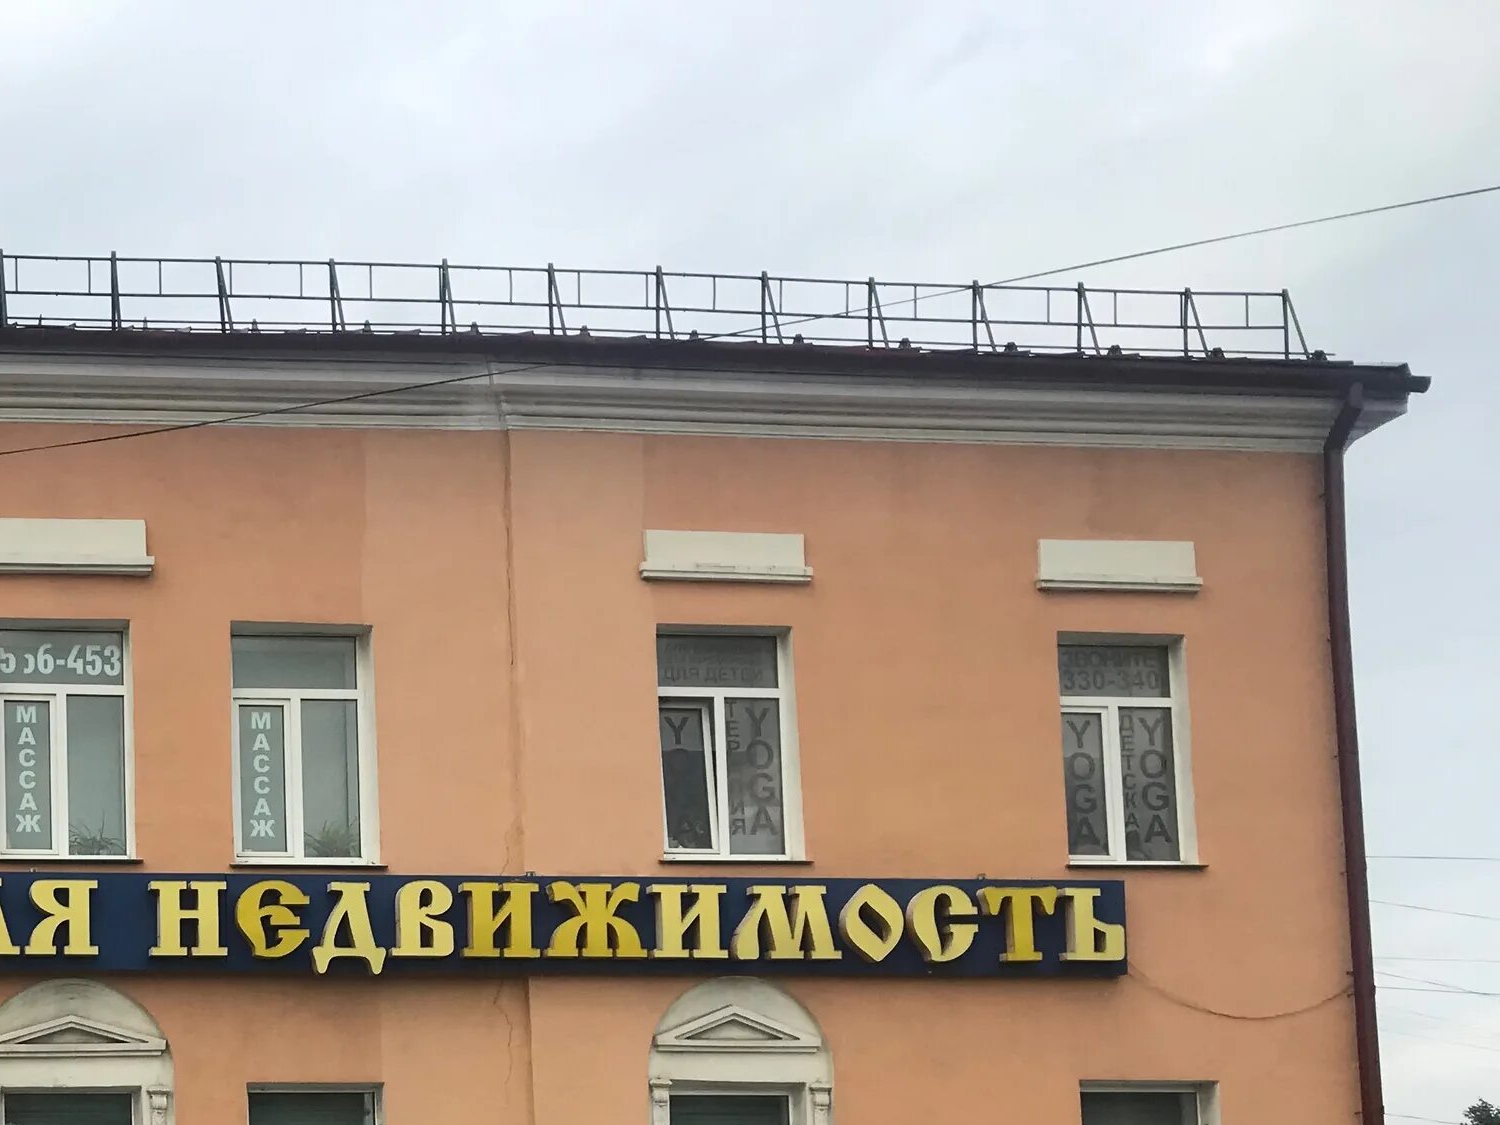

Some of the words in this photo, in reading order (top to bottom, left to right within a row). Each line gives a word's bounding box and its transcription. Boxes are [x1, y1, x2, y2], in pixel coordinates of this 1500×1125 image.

[15, 705, 41, 833] МАССАЖ
[250, 712, 275, 838] МАССАЖ
[725, 701, 747, 835] ТЕРПИЯ
[745, 707, 779, 836] YOGA
[1066, 719, 1100, 845] YOGA
[1139, 716, 1173, 844] YOGA
[147, 880, 1126, 976] НЕДВИЖИМОСТЬ
